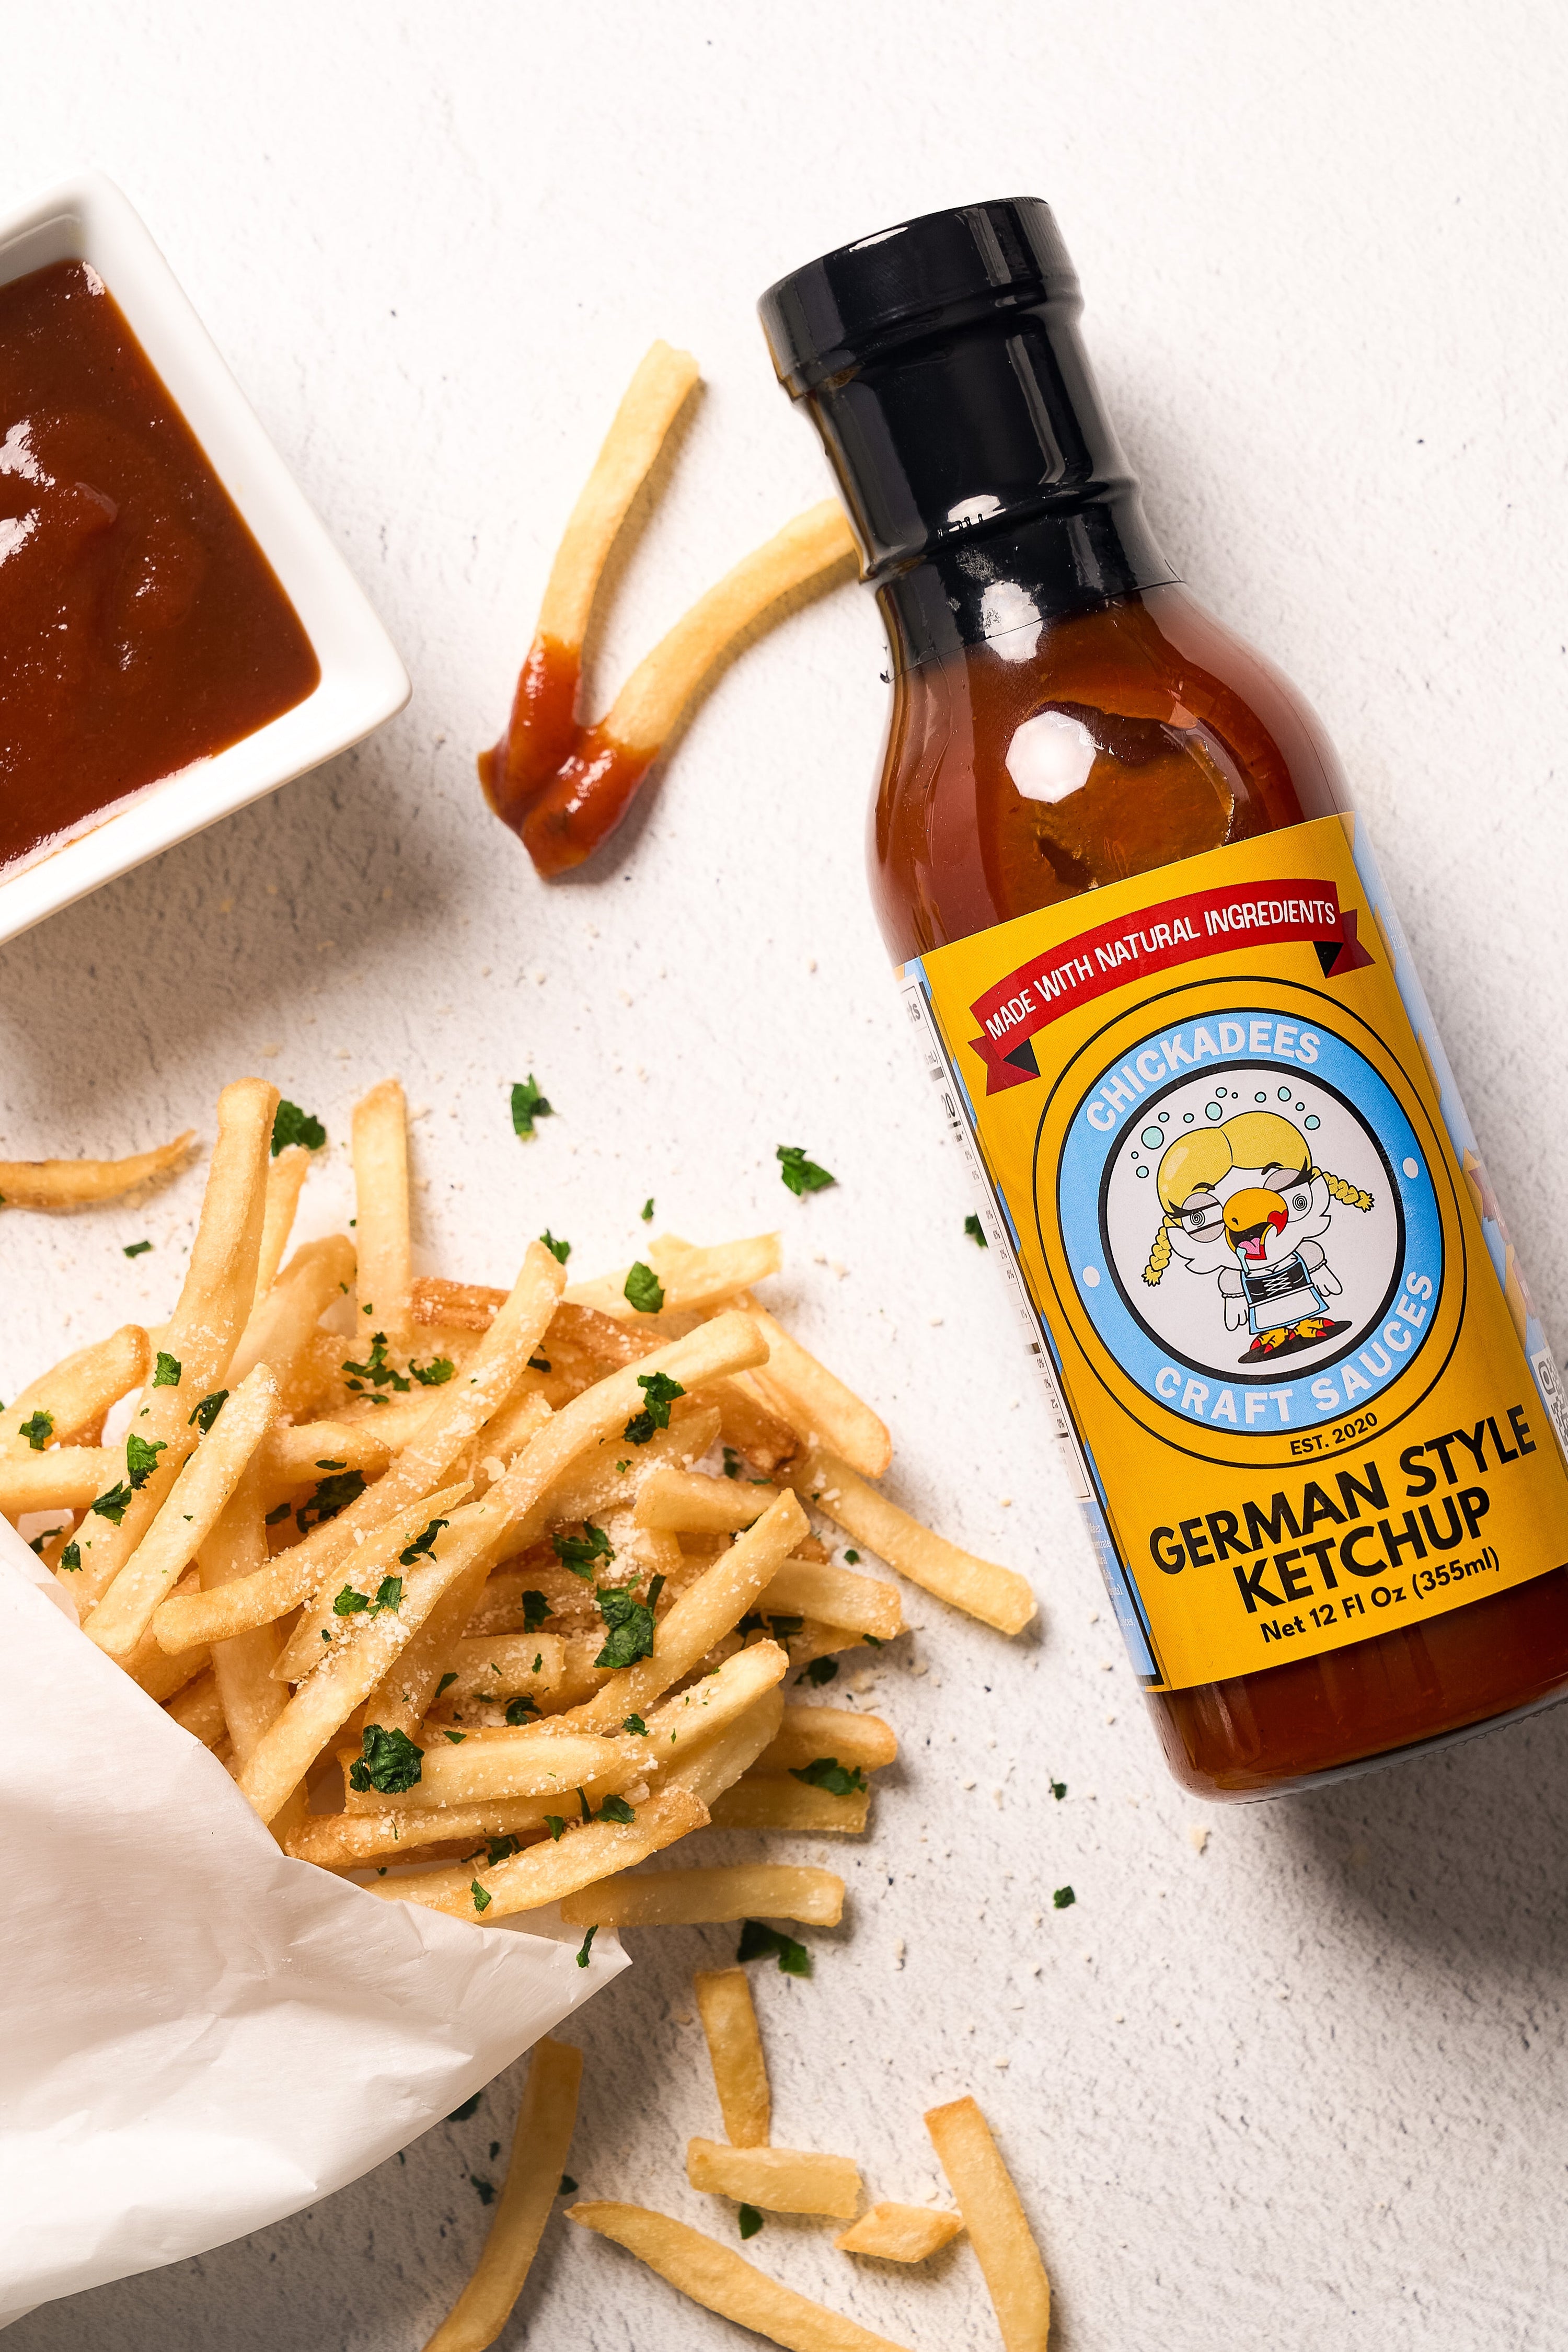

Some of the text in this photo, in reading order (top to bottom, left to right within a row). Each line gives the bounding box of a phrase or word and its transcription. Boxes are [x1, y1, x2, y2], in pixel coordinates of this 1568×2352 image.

[985, 900, 1336, 1040] MADE WITH NATURAL INGREDIENTS
[1087, 1020, 1321, 1132] CHICKADEES
[1155, 1271, 1433, 1425] CRAFT SAUCES
[1149, 1404, 1538, 1575] GERMAN STYLE
[1290, 1412, 1378, 1456] EST. 2020
[1232, 1486, 1491, 1614] KETCHUP
[1260, 1545, 1500, 1643] Net 12 Fl Oz (355ml)
